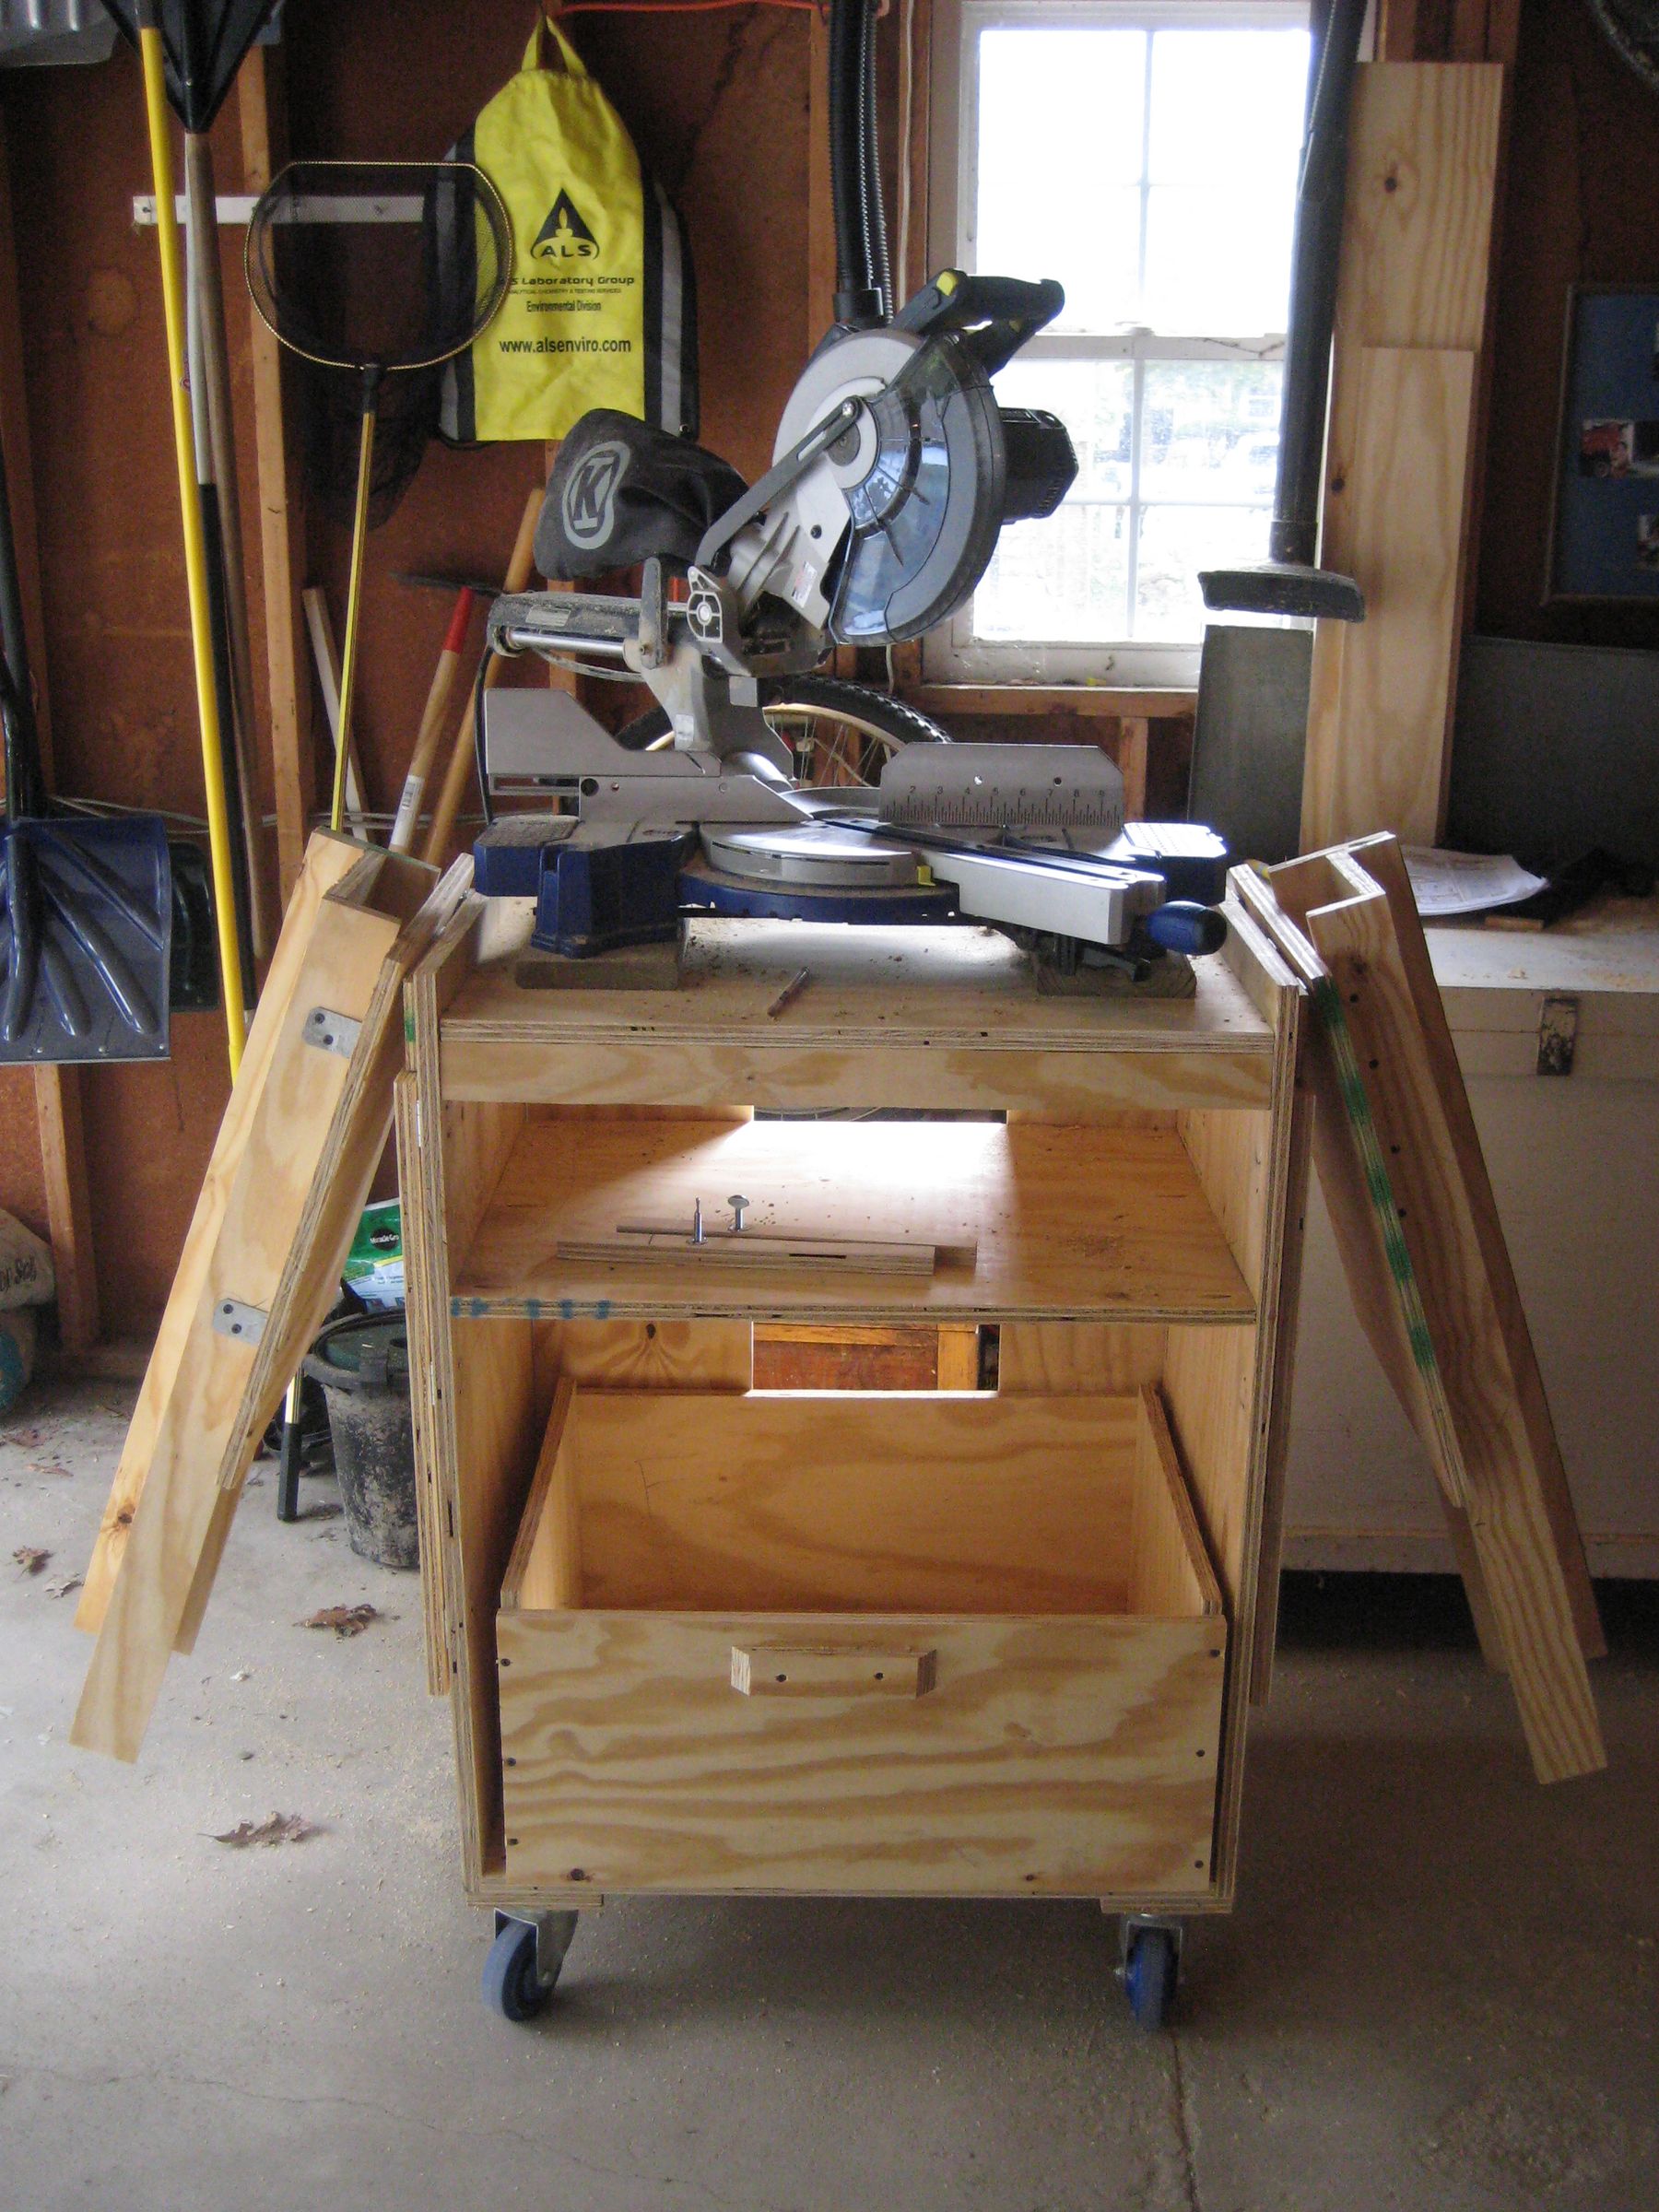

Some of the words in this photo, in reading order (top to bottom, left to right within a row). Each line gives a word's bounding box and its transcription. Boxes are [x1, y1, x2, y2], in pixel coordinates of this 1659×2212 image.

[540, 244, 592, 258] ALS
[522, 276, 593, 288] Laboratory
[597, 276, 635, 287] Group
[526, 300, 575, 312] Environmental
[577, 300, 602, 312] Division
[499, 336, 631, 353] www.alsenviro.com
[909, 785, 916, 794] 2
[936, 785, 944, 794] 3
[1019, 788, 1026, 796] 6
[1047, 789, 1053, 797] 7
[1073, 789, 1079, 798] 8
